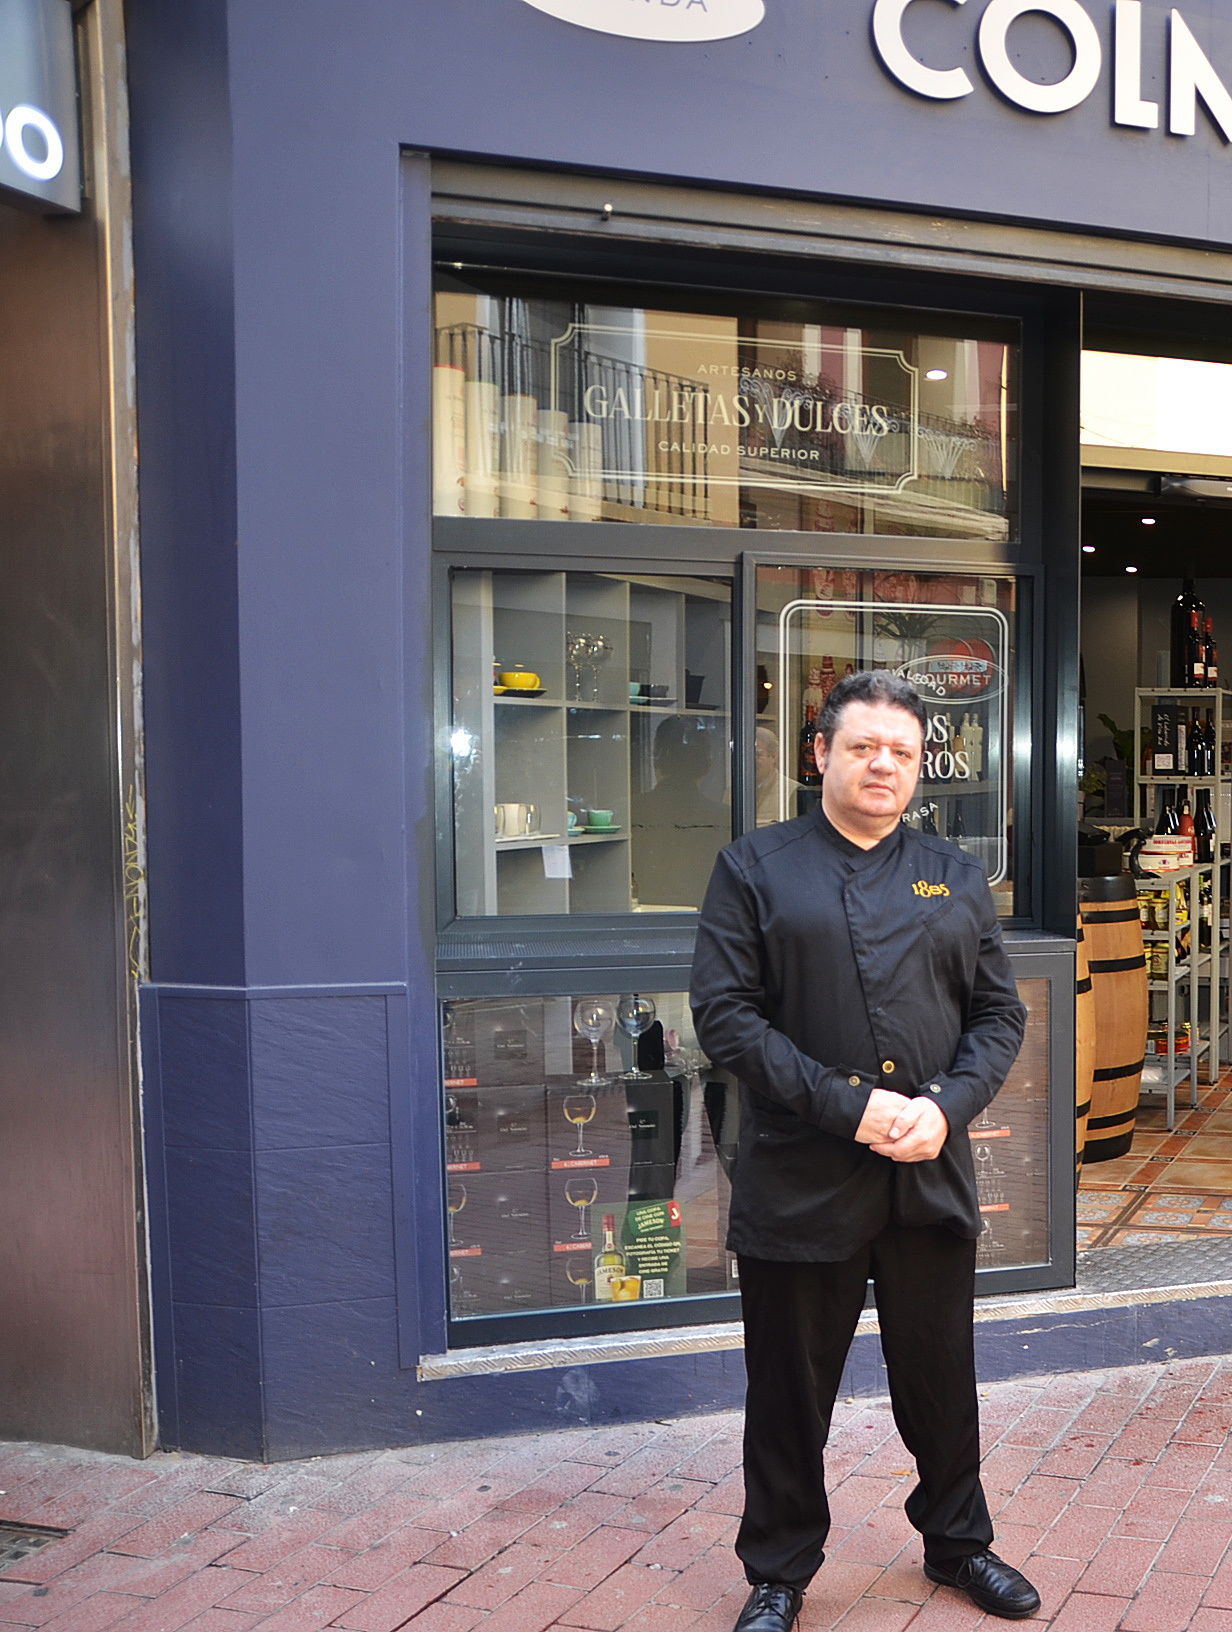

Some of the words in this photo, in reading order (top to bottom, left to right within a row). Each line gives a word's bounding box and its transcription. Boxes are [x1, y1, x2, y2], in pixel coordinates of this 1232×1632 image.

[697, 364, 797, 381] ARTESANOS
[583, 384, 750, 427] GALLETAS
[753, 402, 767, 424] Y
[772, 397, 889, 437] DULCES
[658, 440, 731, 456] CALIDAD
[736, 444, 820, 461] SUPERIOR
[912, 673, 992, 687] GOURMET
[902, 801, 939, 823] RASA
[671, 1207, 680, 1220] J
